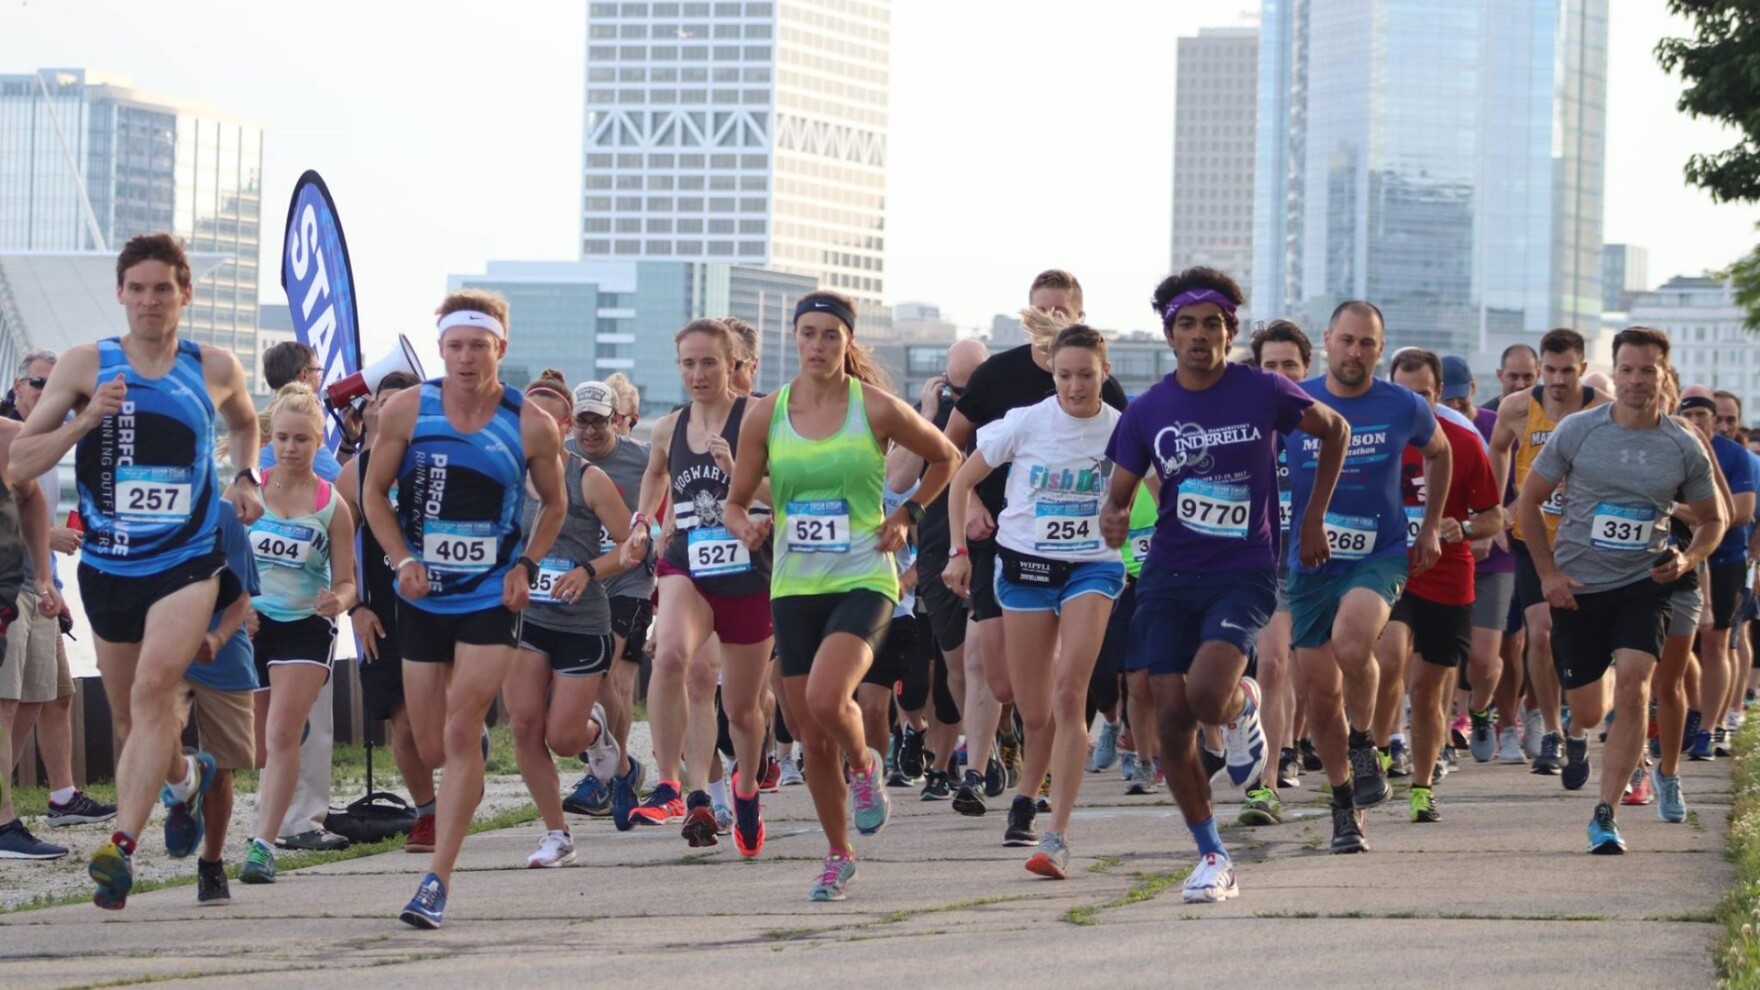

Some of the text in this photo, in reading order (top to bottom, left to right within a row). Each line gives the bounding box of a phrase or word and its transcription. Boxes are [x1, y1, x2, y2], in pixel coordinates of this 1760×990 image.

[1030, 464, 1074, 489] Fish
[129, 487, 179, 510] 257
[1181, 498, 1247, 525] 9770
[796, 520, 835, 540] 521
[1046, 520, 1090, 540] 254
[1327, 530, 1366, 550] 268
[1602, 521, 1643, 541] 331
[258, 537, 299, 559] 404
[436, 540, 485, 561] 405
[698, 544, 738, 565] 527
